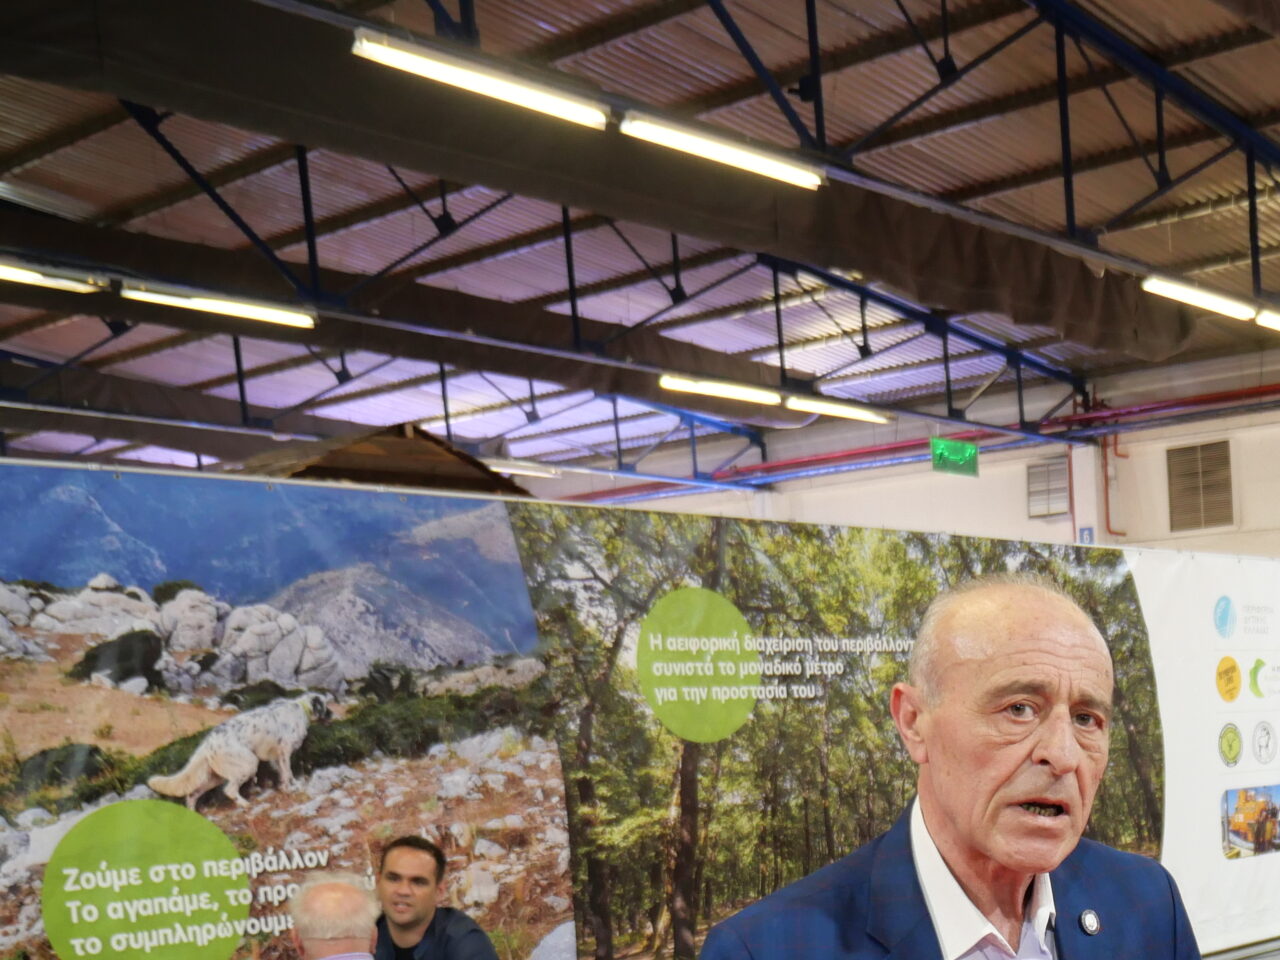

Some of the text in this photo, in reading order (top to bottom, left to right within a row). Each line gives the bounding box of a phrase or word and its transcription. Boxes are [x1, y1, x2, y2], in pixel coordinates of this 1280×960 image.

[649, 630, 915, 656] Η αειφορική διαχείριση του περιβάλλοντ
[653, 654, 844, 679] συνιστά το μοναδικό μέτρο
[655, 686, 678, 706] για
[682, 686, 708, 705] την
[711, 679, 787, 705] προστασία
[62, 846, 329, 892] Ζούμε στο περιβάλλον
[66, 886, 252, 924] Το αγαπάμε, το
[70, 935, 102, 956] το
